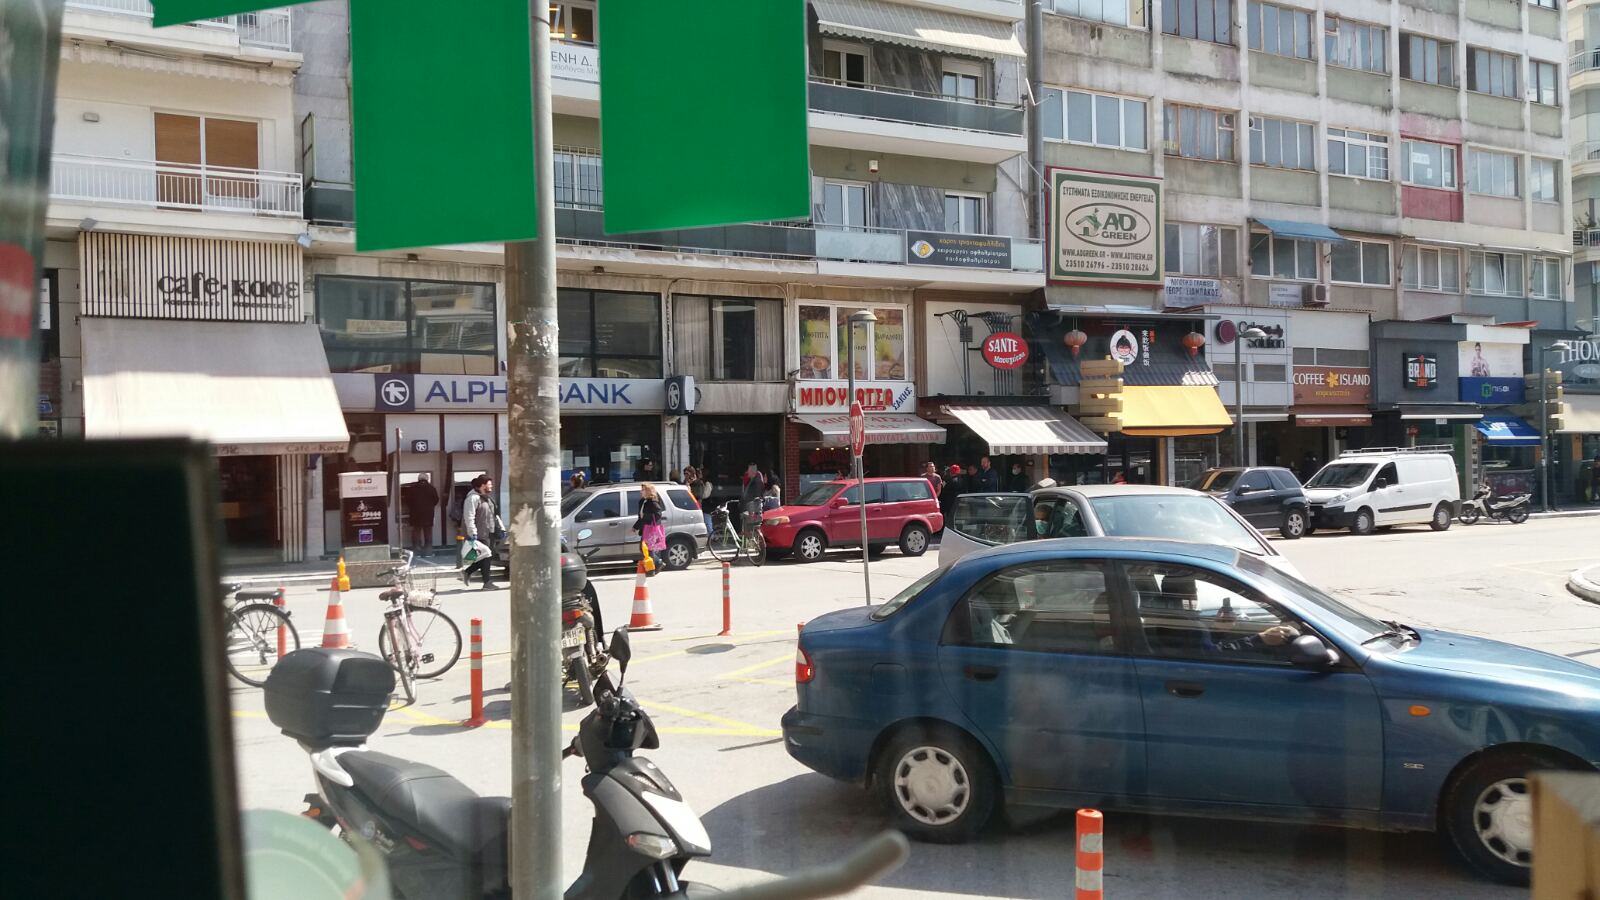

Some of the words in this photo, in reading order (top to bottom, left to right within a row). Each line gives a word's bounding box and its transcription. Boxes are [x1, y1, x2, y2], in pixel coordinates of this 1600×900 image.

[1102, 212, 1137, 232] AD
[1101, 231, 1137, 241] GREEN
[1062, 248, 1106, 258] WWW.ADGREEN.GR
[1110, 250, 1153, 261] WWW.ADTHERM.GR
[1065, 260, 1085, 268] 23510
[988, 337, 1019, 352] SANTE
[1408, 362, 1437, 378] BRAND
[1293, 373, 1326, 385] COFFEE
[1340, 373, 1371, 386] ISLAND
[425, 380, 507, 403] ALPH
[800, 386, 894, 407] ΜΠΟΥΑΤΣΑ
